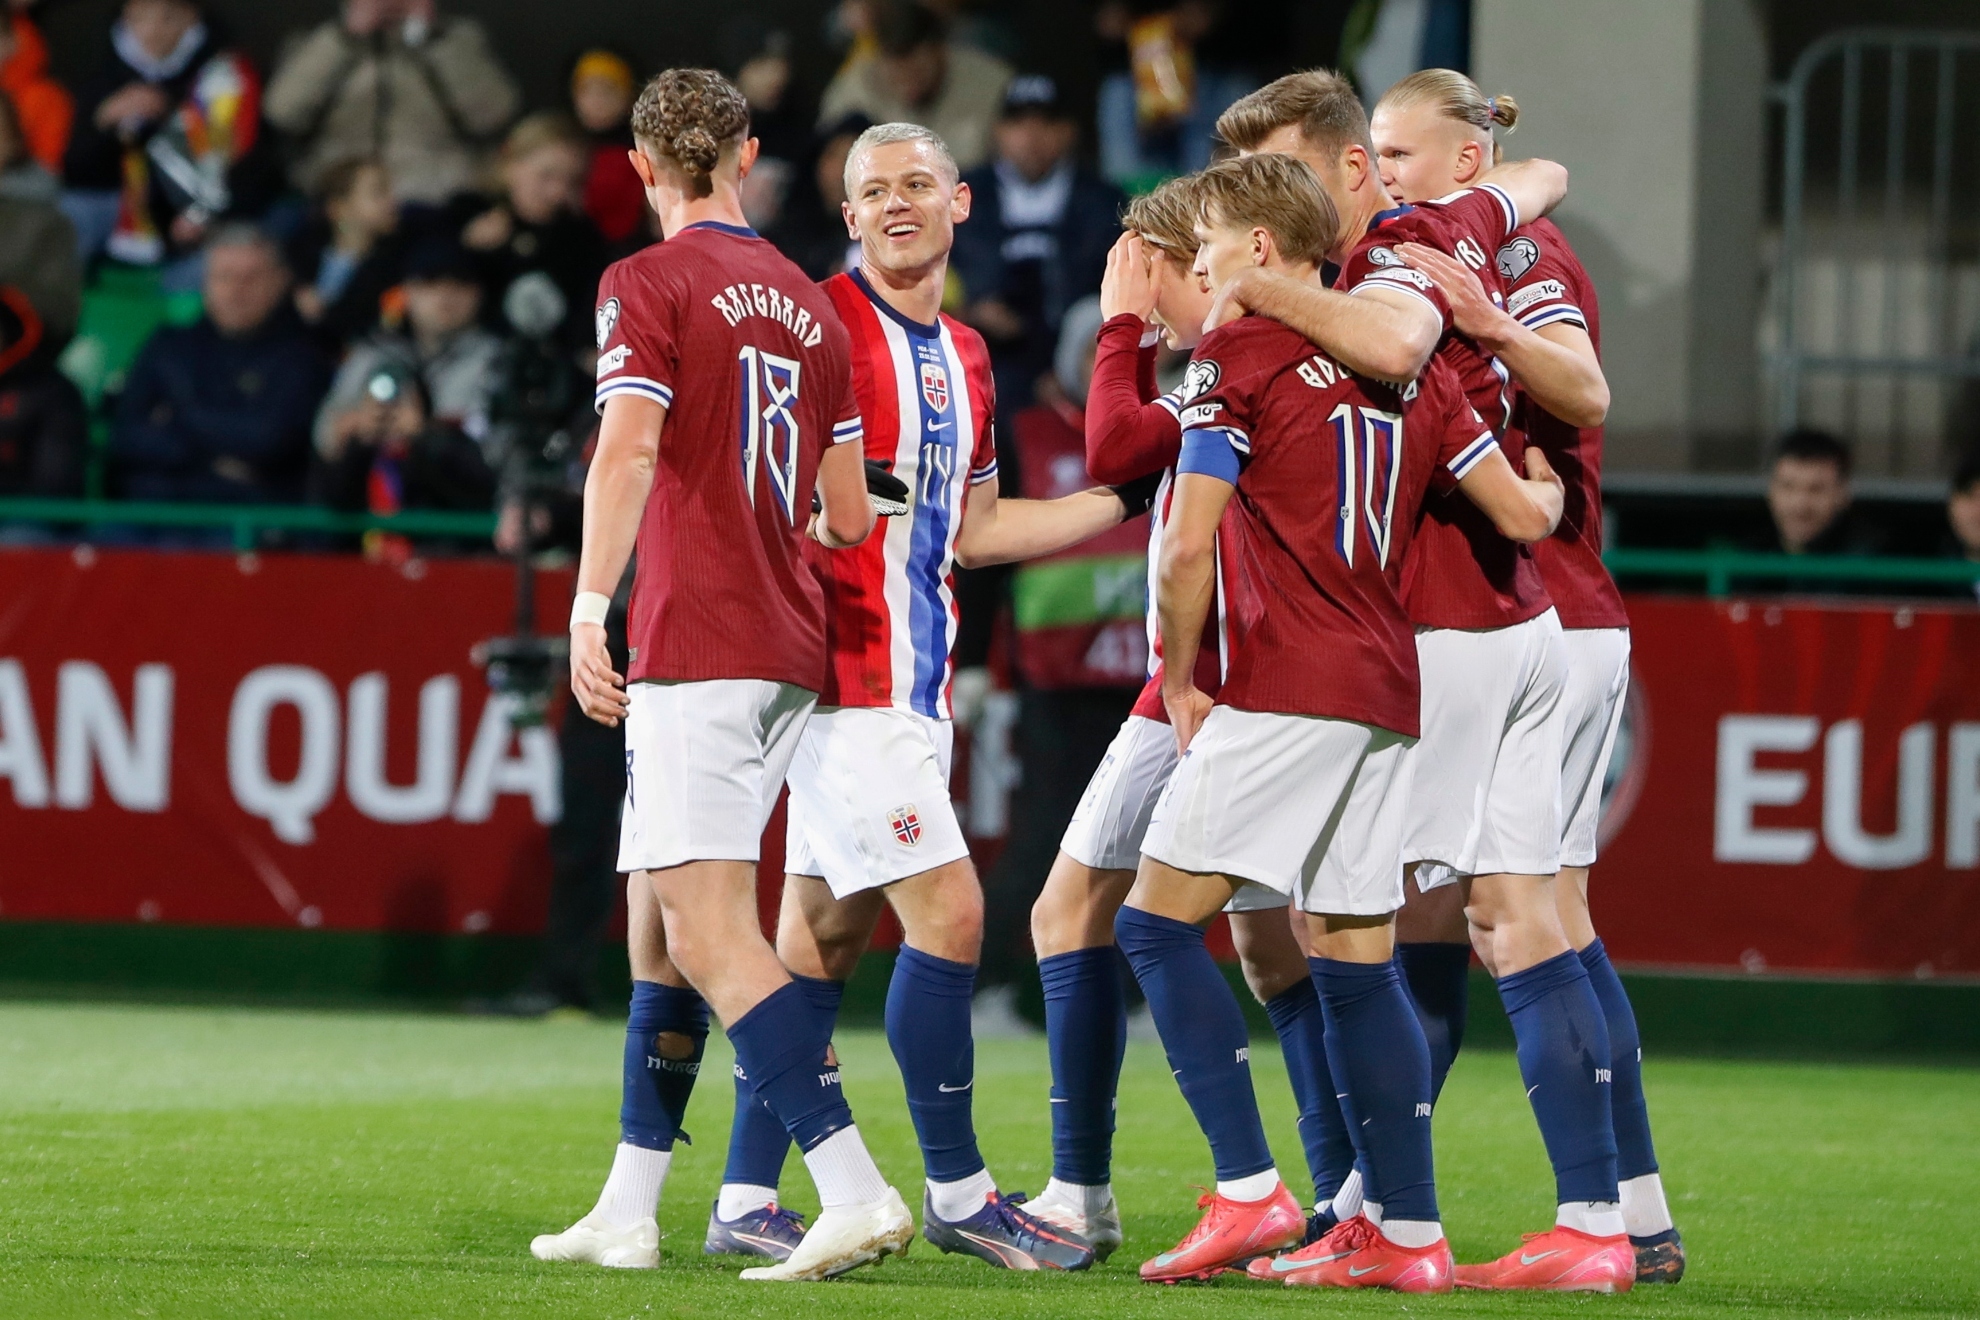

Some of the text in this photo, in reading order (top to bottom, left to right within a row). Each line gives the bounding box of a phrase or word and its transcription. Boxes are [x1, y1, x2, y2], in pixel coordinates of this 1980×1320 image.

[738, 345, 801, 527] 18
[922, 442, 952, 510] 14
[1327, 403, 1403, 572] 10
